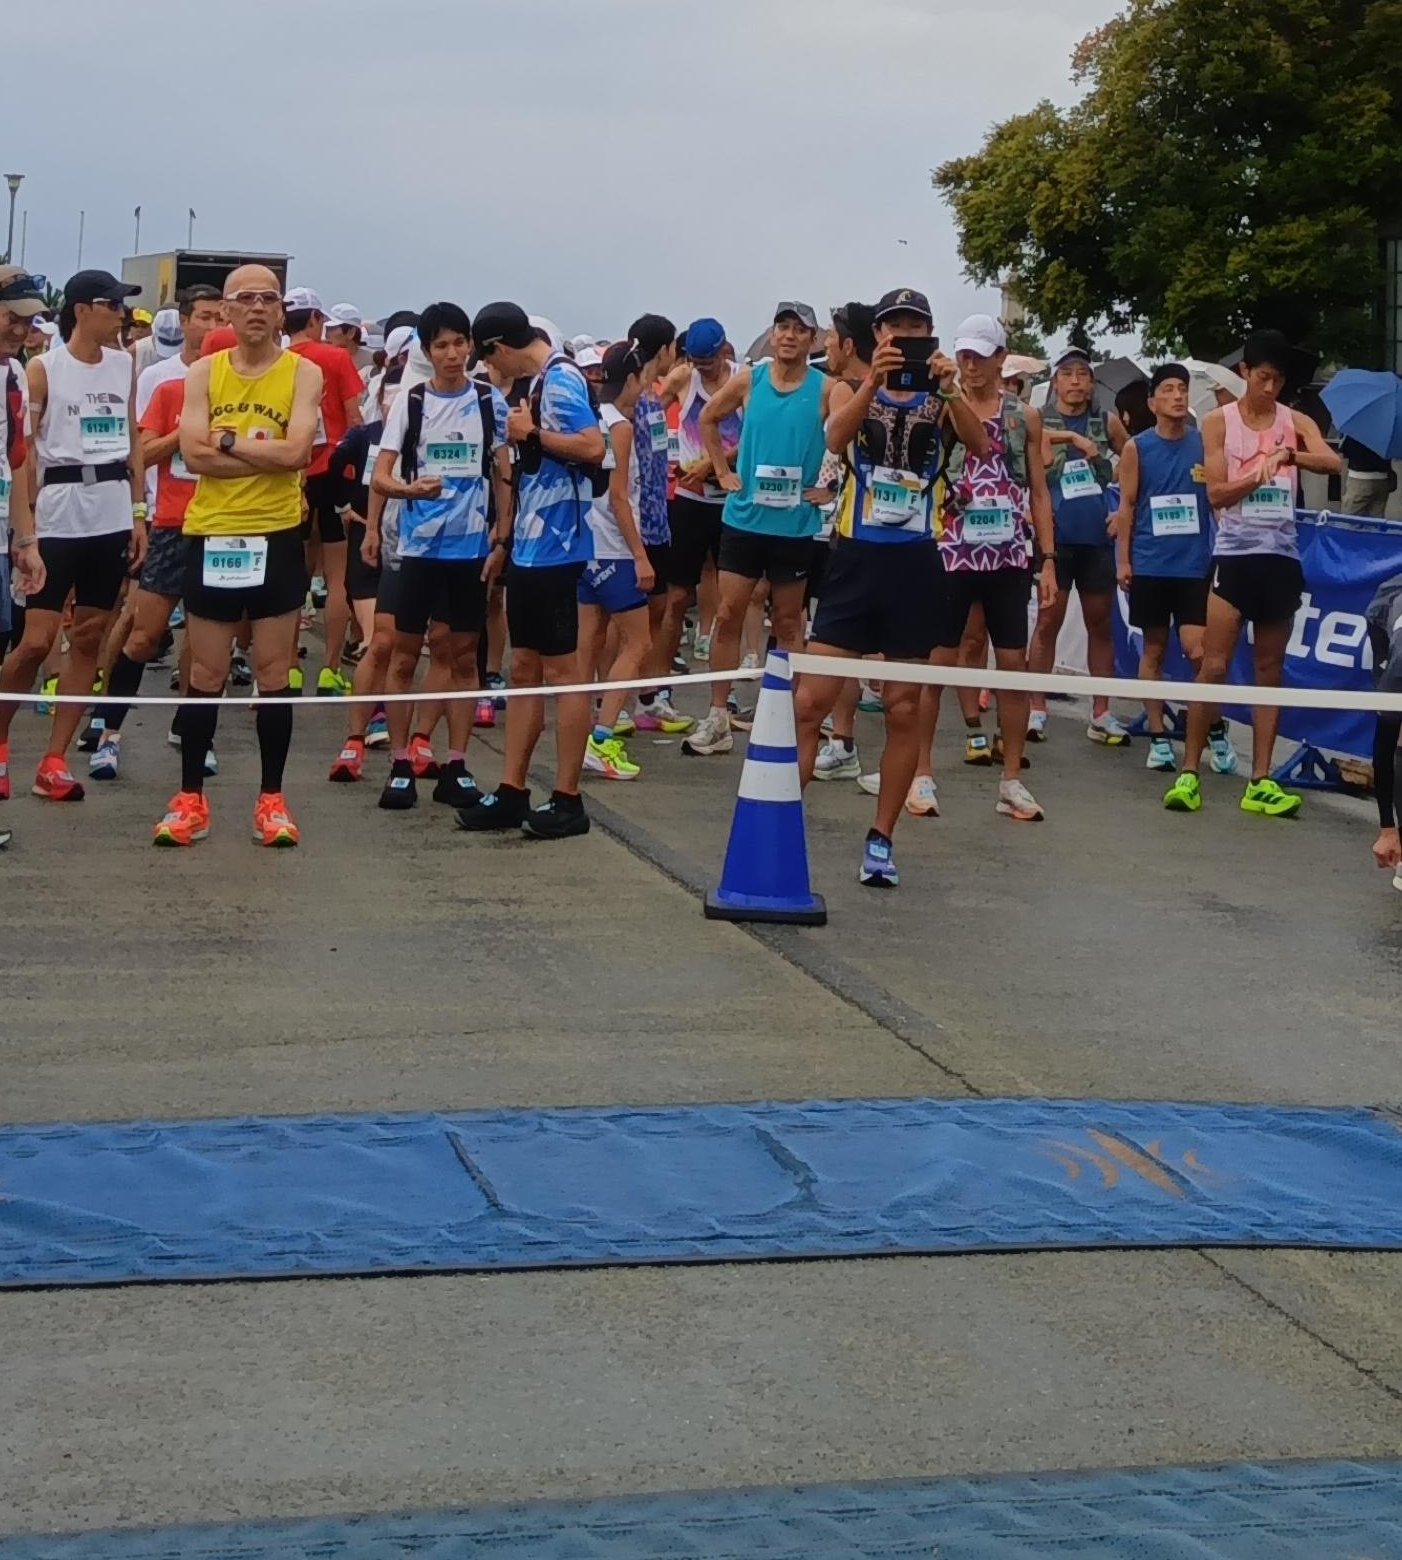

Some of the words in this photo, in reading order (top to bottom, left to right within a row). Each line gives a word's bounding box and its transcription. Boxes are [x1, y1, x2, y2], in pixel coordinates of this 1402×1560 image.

[86, 393, 108, 404] THE
[433, 449, 460, 459] 6324
[969, 514, 995, 525] 6204
